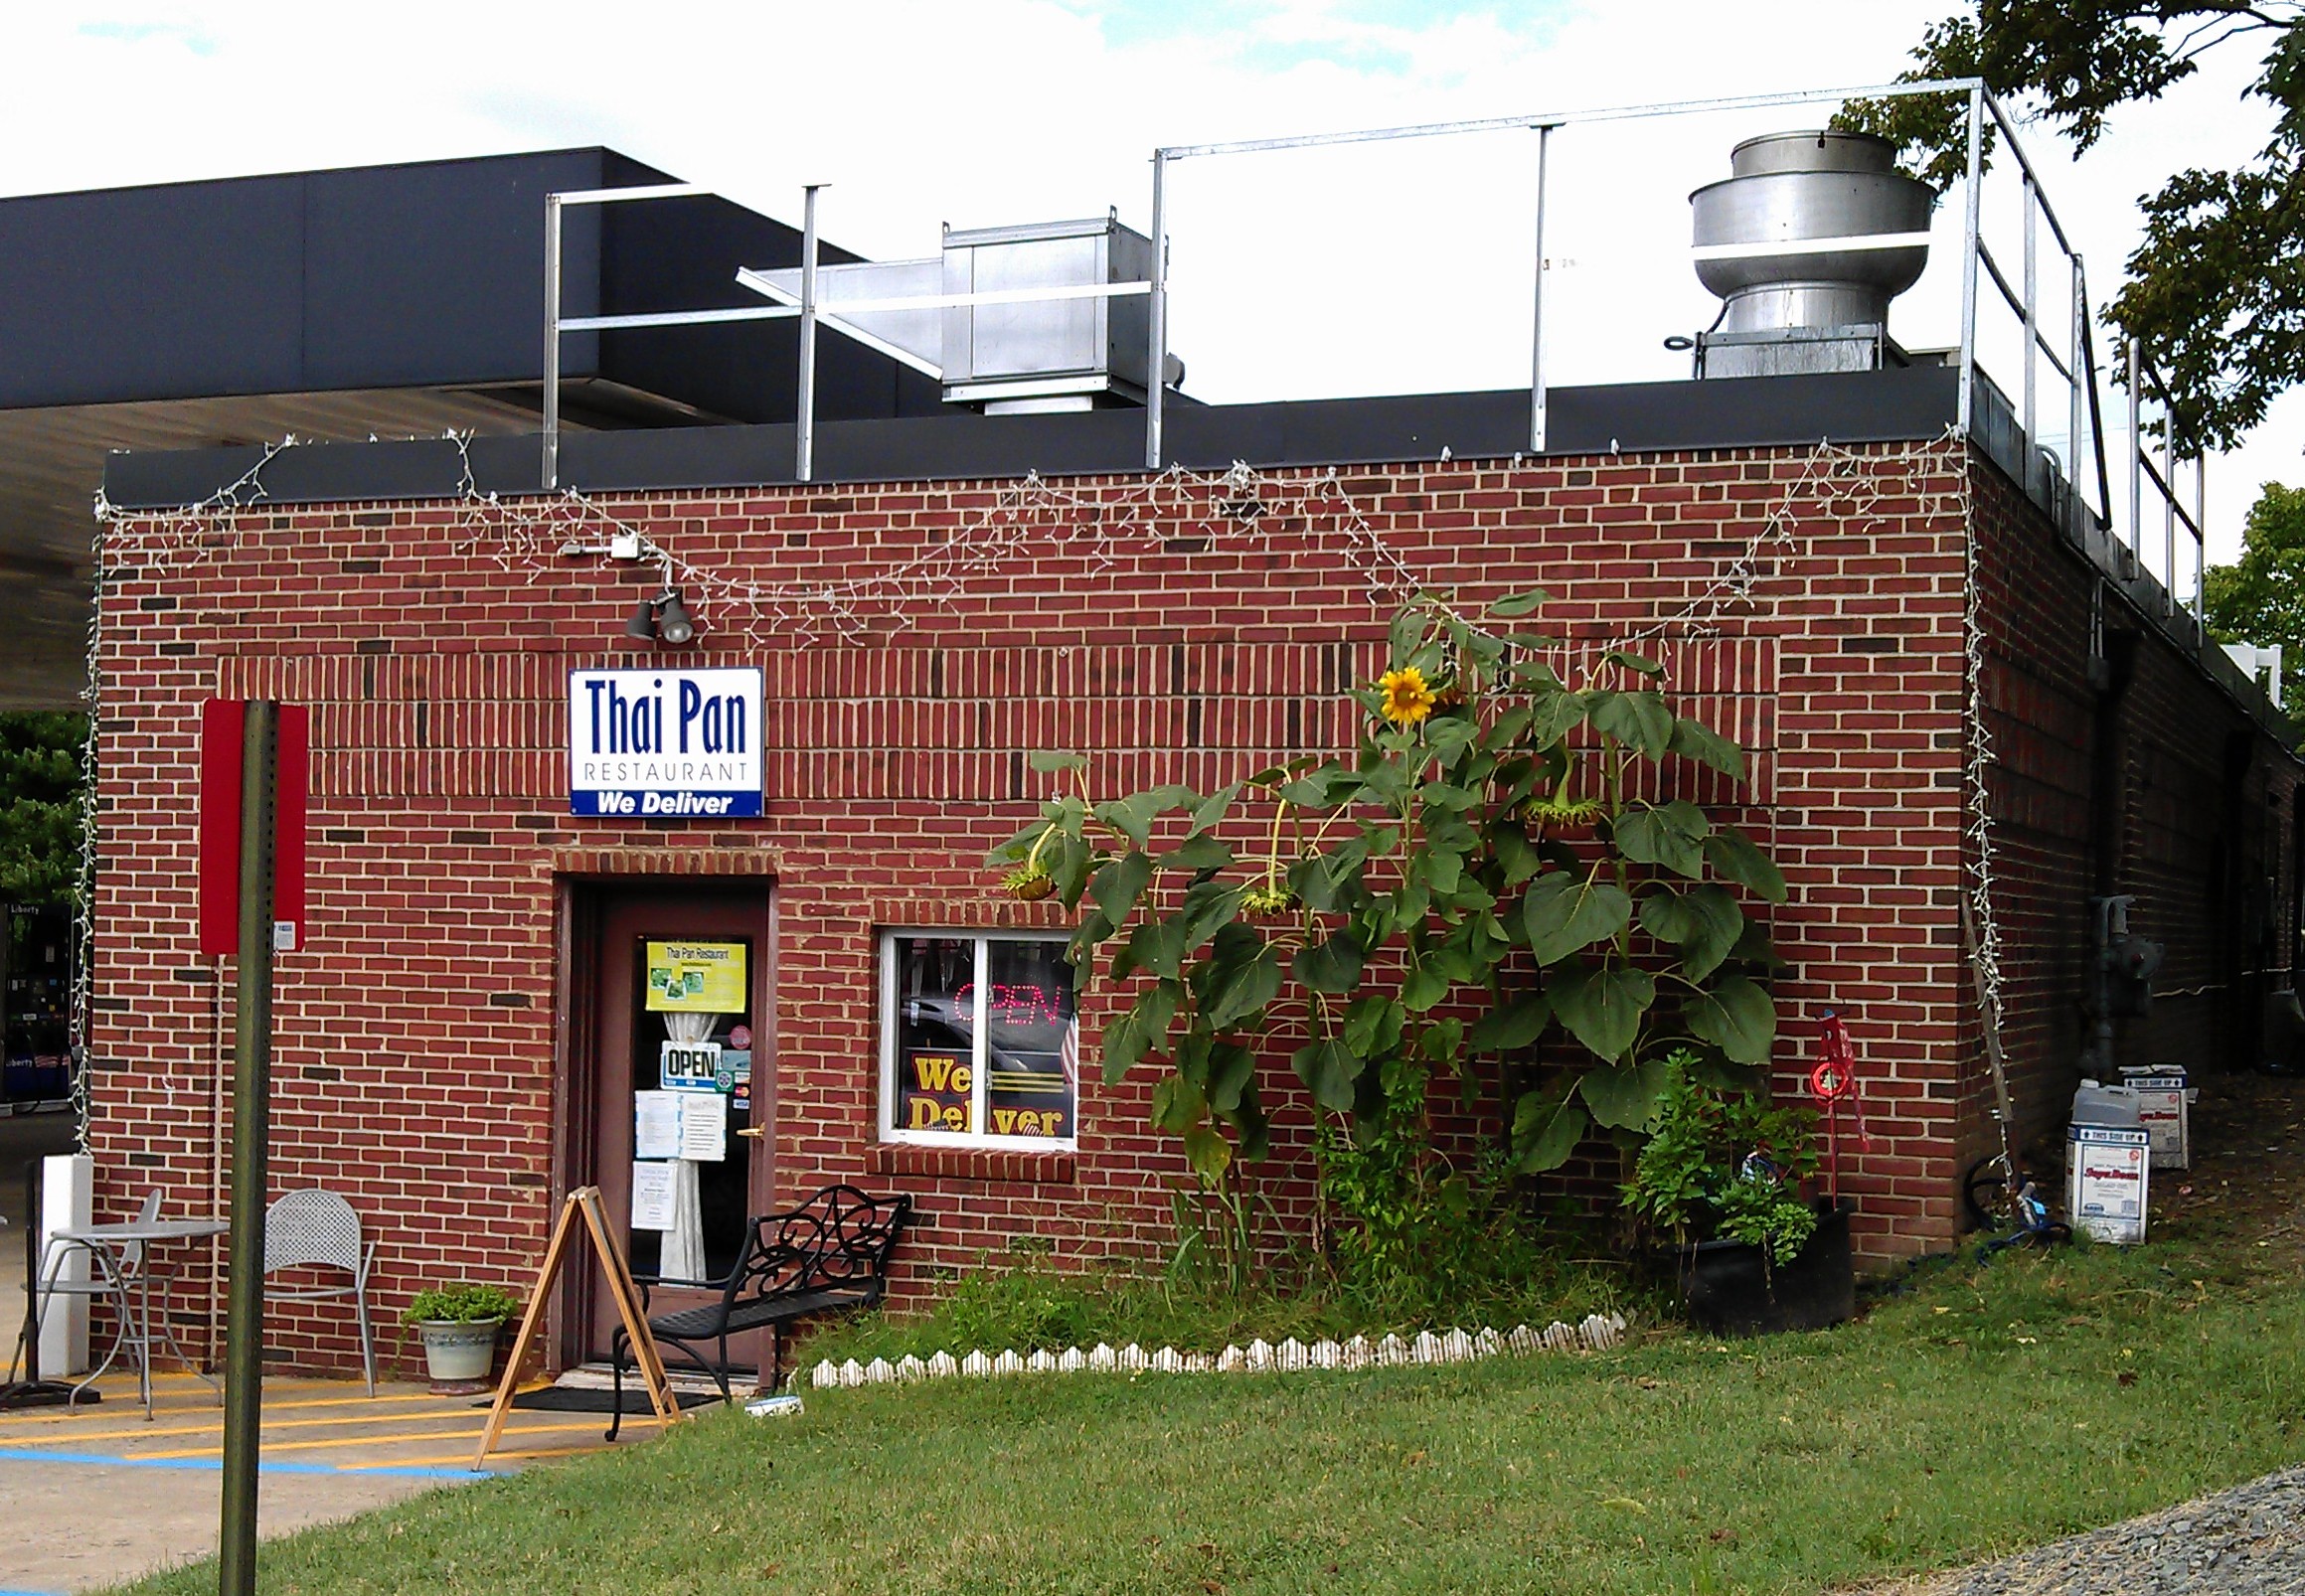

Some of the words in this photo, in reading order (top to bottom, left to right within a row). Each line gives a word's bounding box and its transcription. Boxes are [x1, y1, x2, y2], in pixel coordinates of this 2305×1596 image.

[584, 678, 663, 754] Thai
[679, 679, 746, 754] Pan
[584, 762, 747, 781] RESTAURANT
[597, 791, 637, 814] We
[641, 792, 734, 814] Deliver
[10, 904, 40, 915] Liberty
[667, 946, 681, 959] Thai
[682, 947, 695, 959] Pan
[697, 947, 729, 960] Restaurant
[668, 1049, 716, 1077] OPEN
[913, 1056, 972, 1094] We
[908, 1096, 1064, 1138] Delver
[2092, 1131, 2107, 1140] THIS
[2108, 1132, 2123, 1141] SIDE
[2125, 1133, 2136, 1142] UP
